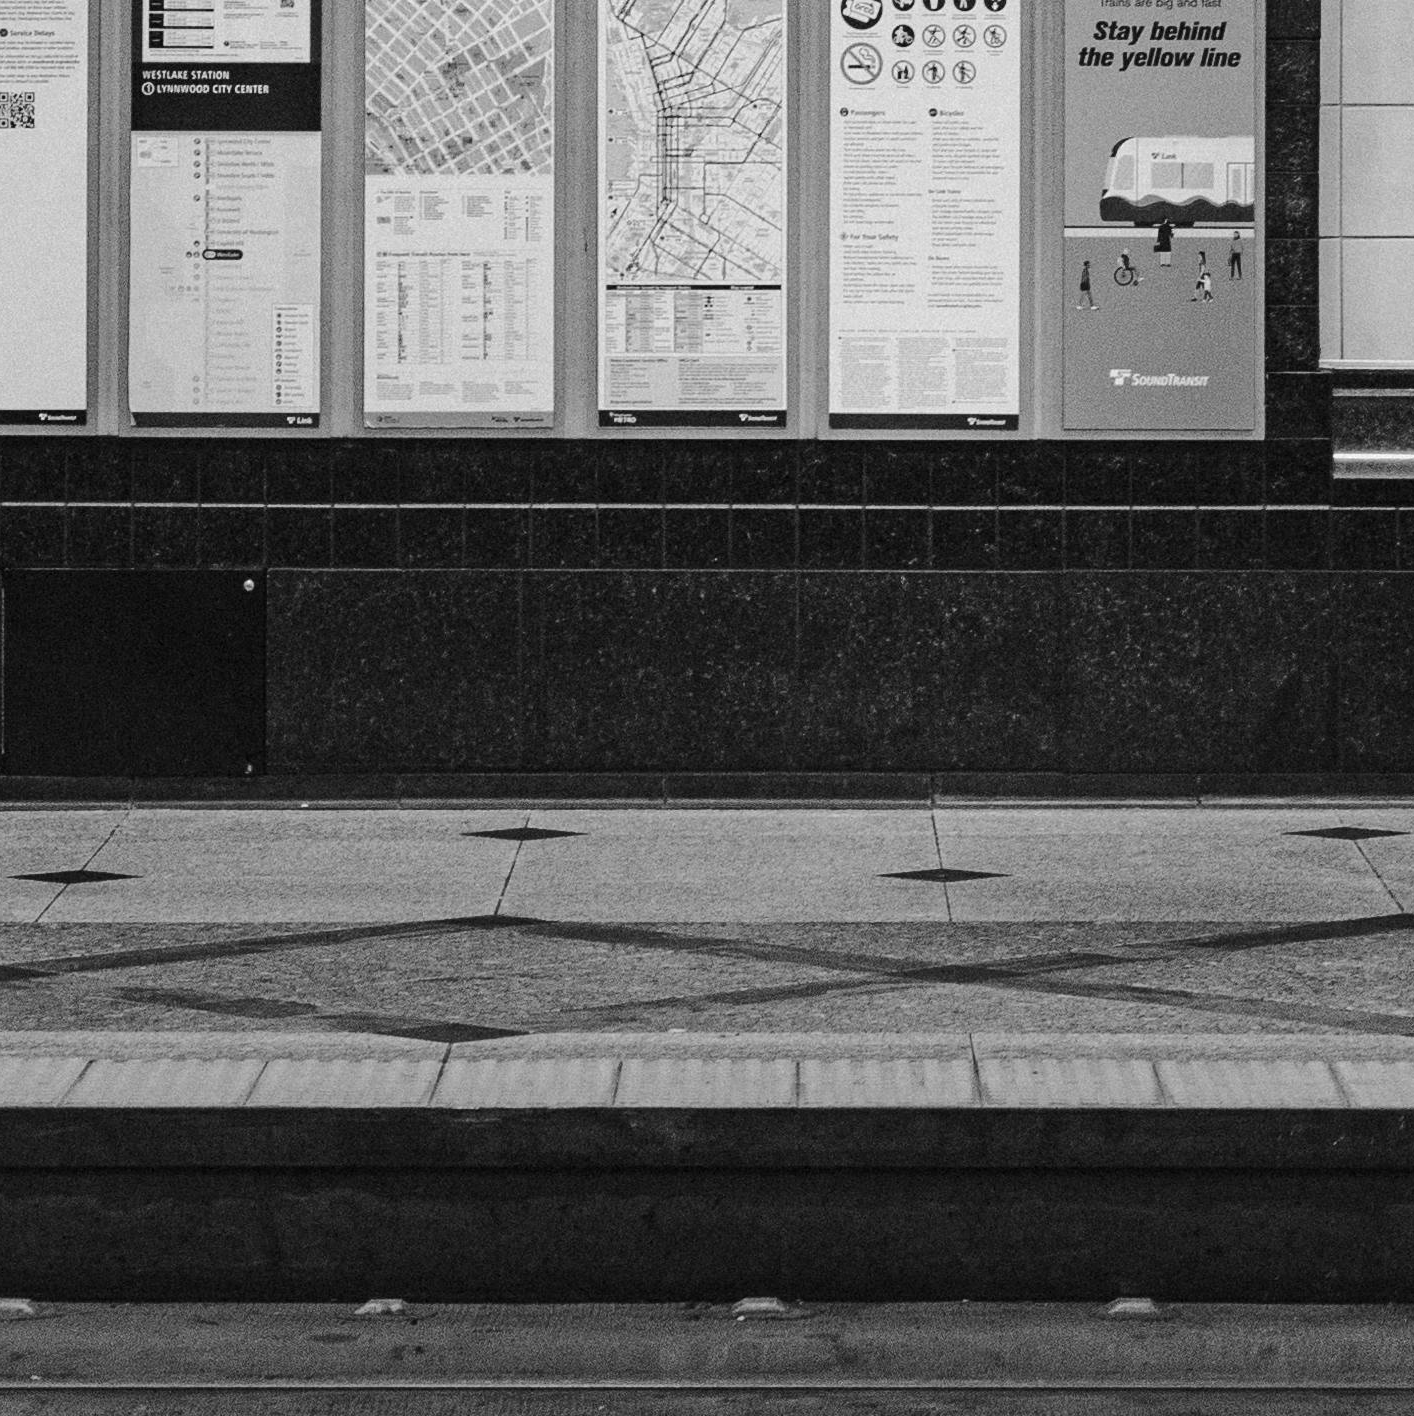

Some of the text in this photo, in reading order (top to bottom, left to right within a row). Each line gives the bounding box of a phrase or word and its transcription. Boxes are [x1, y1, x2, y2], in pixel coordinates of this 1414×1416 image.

[1135, 0, 1153, 8] are
[1093, 21, 1227, 45] Stay behind
[1079, 47, 1241, 71] the yellow line
[142, 70, 230, 80] WESTLAKE STATION
[156, 85, 270, 94] LYNNWOOD CITY CENTER
